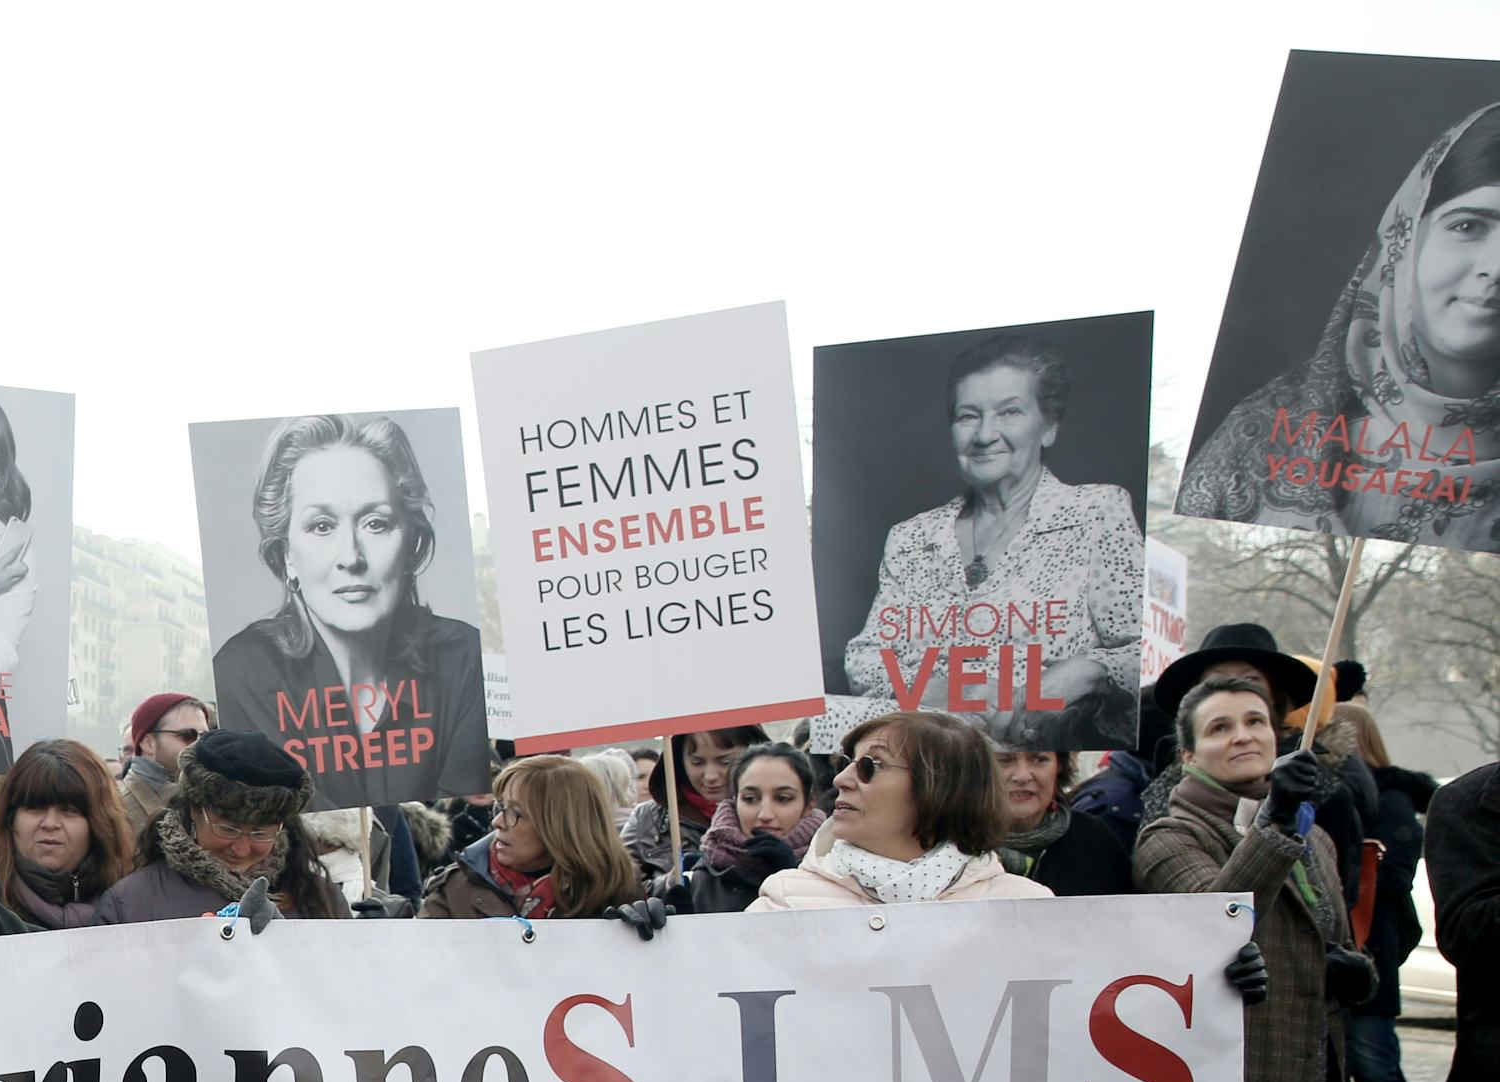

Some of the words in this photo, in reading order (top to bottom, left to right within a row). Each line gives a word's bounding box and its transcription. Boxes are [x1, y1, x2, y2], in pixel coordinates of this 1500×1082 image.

[520, 399, 697, 454] HOMMES
[713, 390, 751, 424] ET
[1269, 407, 1477, 466] MALALA
[525, 438, 760, 513] FEMMES
[1267, 453, 1473, 504] YOUSAFZAI
[532, 496, 766, 562] ENSEMBLE
[538, 569, 622, 603] POUR
[635, 548, 768, 589] BOUGER
[543, 613, 607, 651] LES
[625, 589, 774, 640] LIGNES
[878, 600, 1067, 641] SIMONE
[276, 679, 433, 732] MERYL
[879, 644, 1066, 712] VEIL
[283, 727, 434, 774] STREEP
